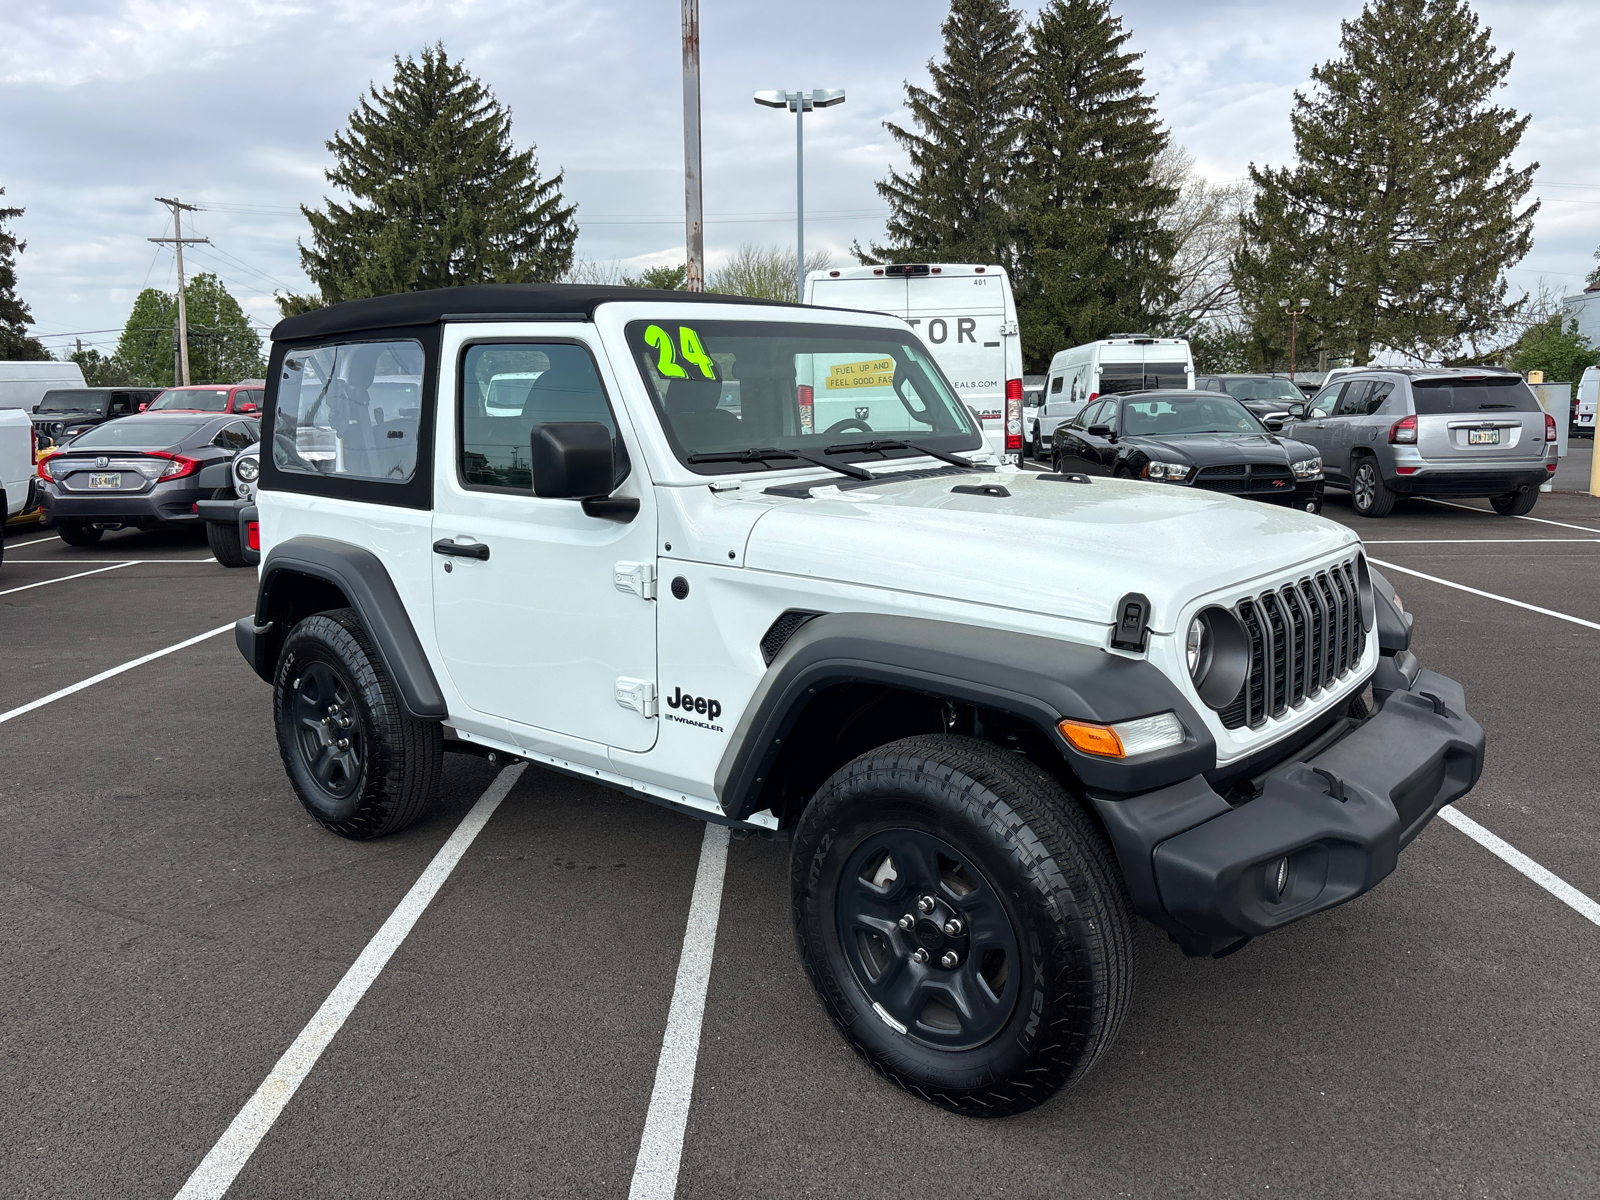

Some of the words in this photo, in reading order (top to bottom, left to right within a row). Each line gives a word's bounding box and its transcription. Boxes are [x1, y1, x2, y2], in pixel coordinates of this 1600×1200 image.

[645, 325, 716, 379] 24
[835, 366, 855, 375] FUEL
[859, 364, 870, 372] UP
[873, 362, 889, 370] AND
[853, 377, 874, 385] GOOD
[666, 686, 721, 721] Jeep
[673, 715, 723, 733] WRANGLER
